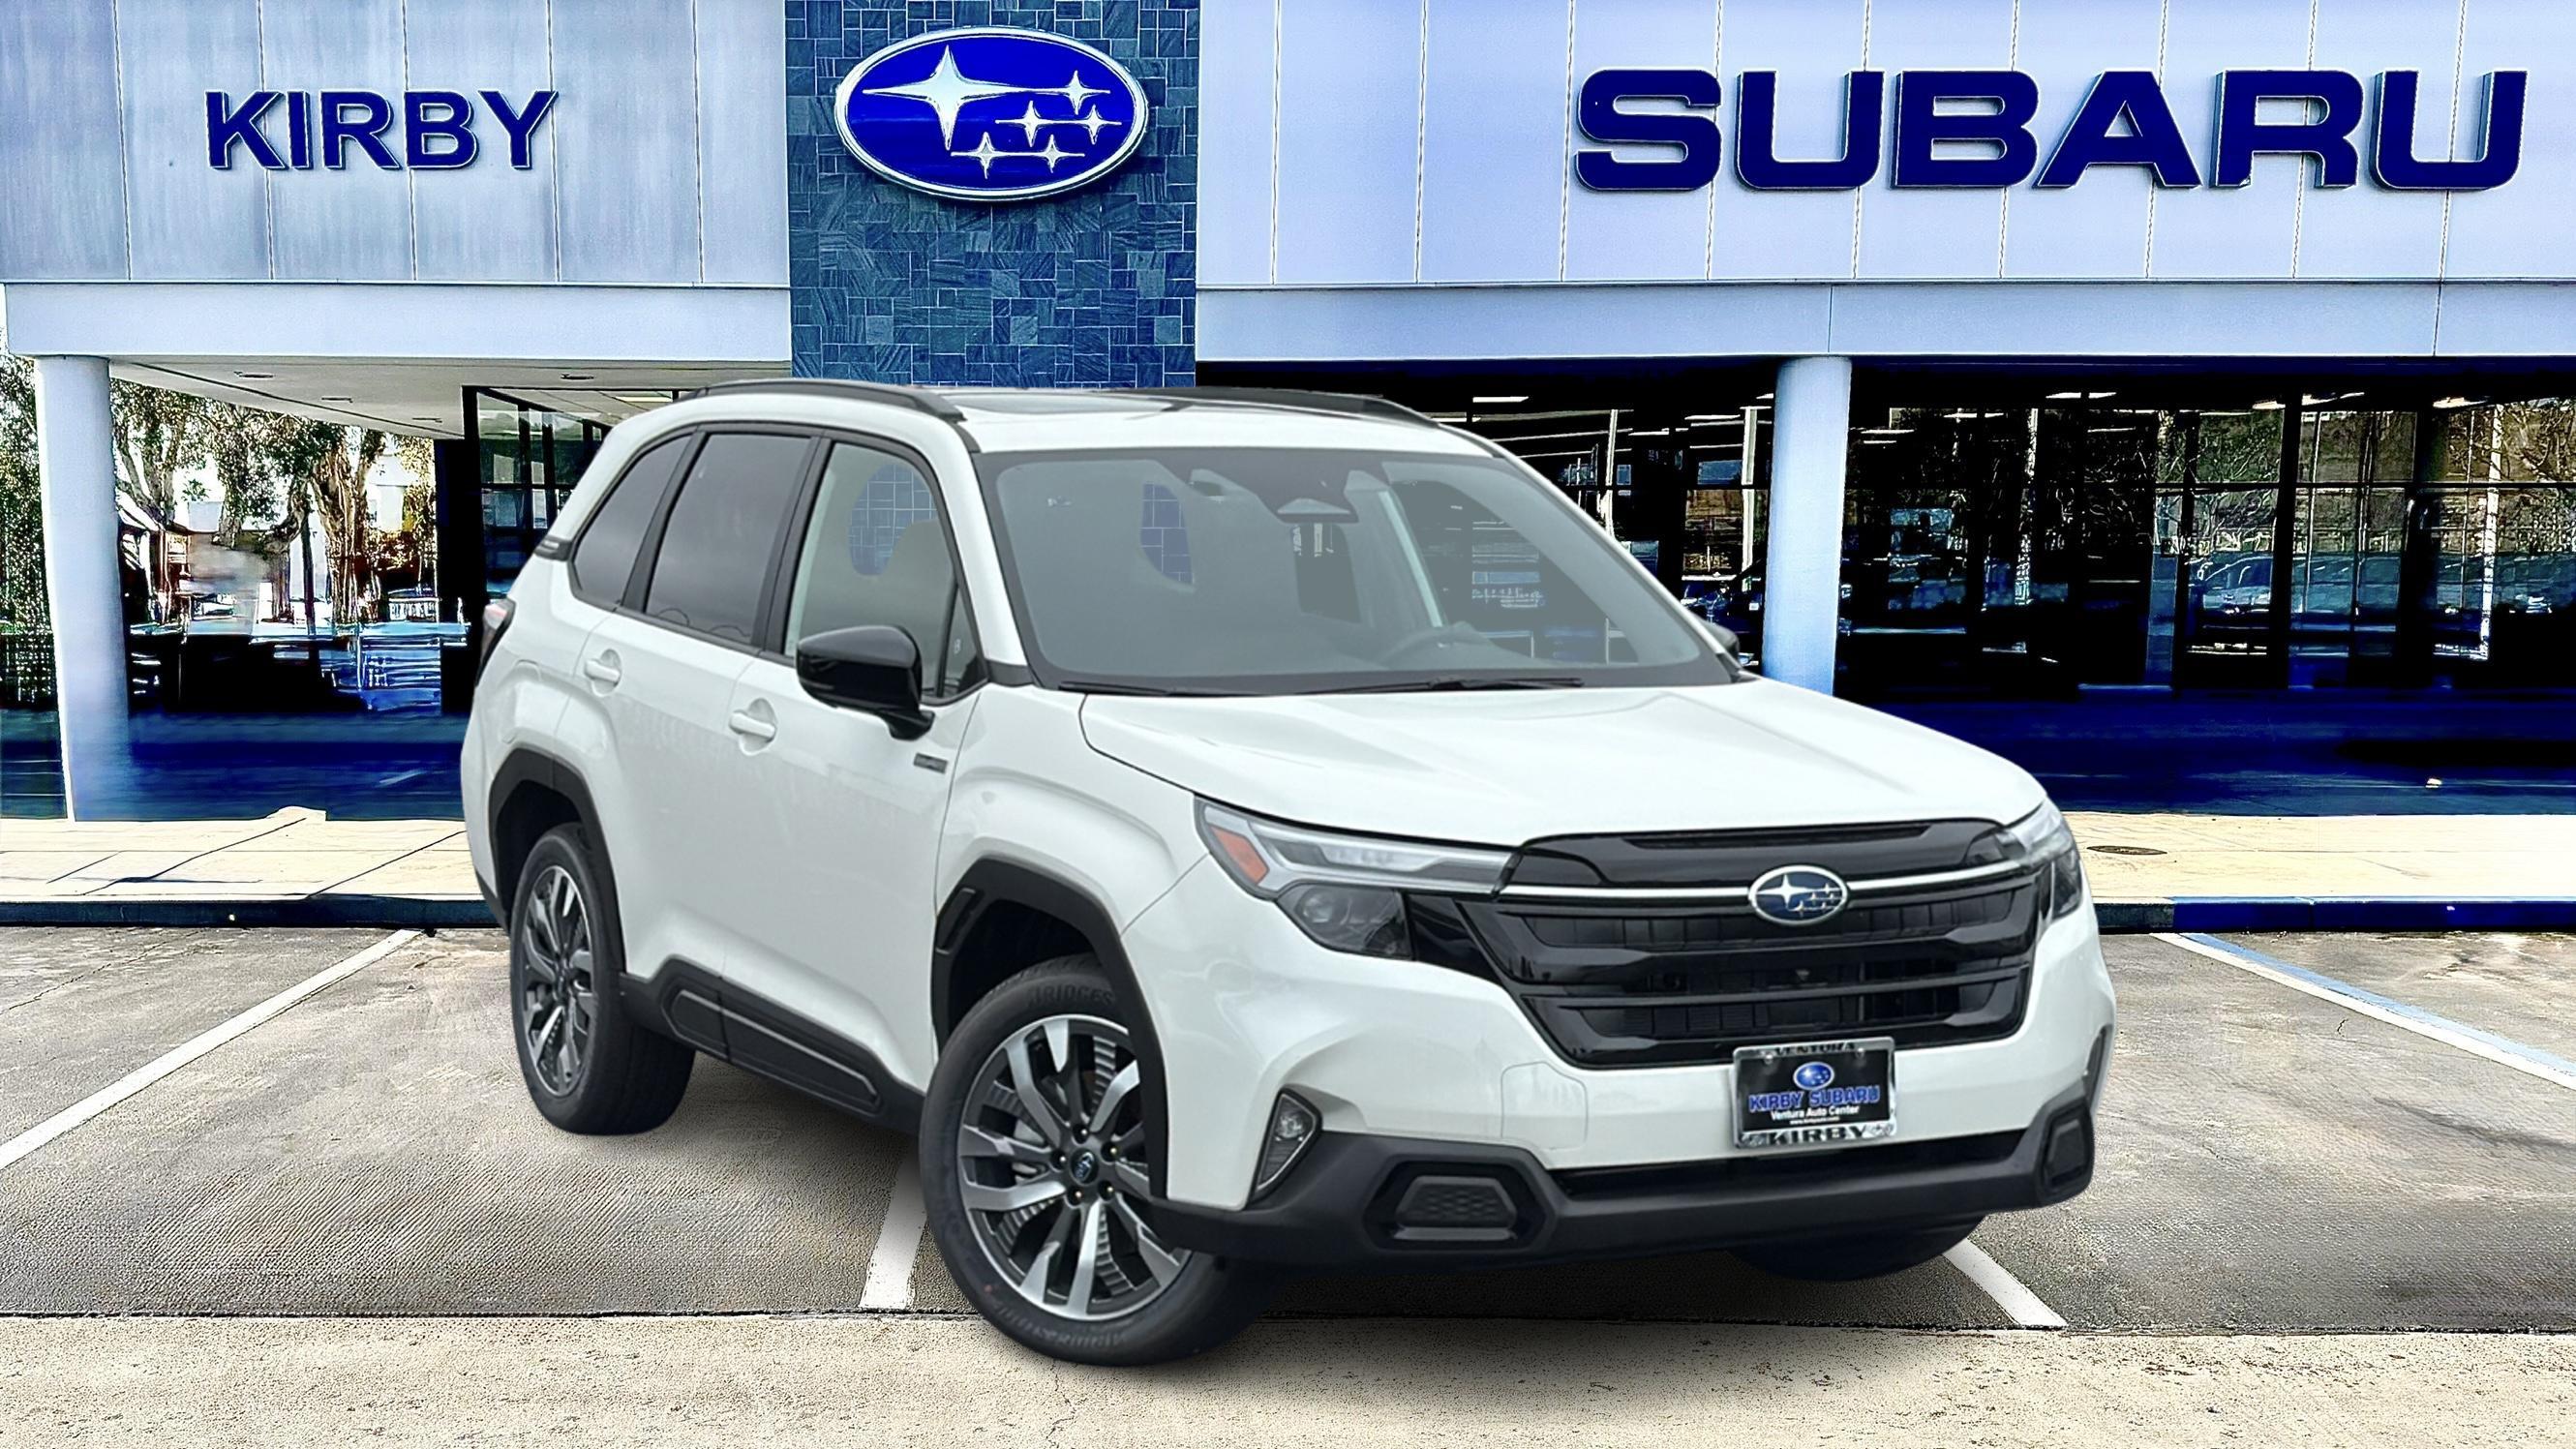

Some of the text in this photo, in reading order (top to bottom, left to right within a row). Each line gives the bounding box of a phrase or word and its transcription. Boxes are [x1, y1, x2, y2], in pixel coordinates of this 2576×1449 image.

[204, 90, 559, 170] KIRBY
[1574, 68, 2528, 191] SUBARU
[1775, 1042, 1855, 1056] VENTURA
[1749, 1086, 1880, 1113] KIRBY SUBARU
[1771, 1108, 1805, 1121] Ventura
[1805, 1106, 1827, 1117] Auto
[1829, 1105, 1860, 1115] Center
[1769, 1125, 1866, 1145] KIRBY
